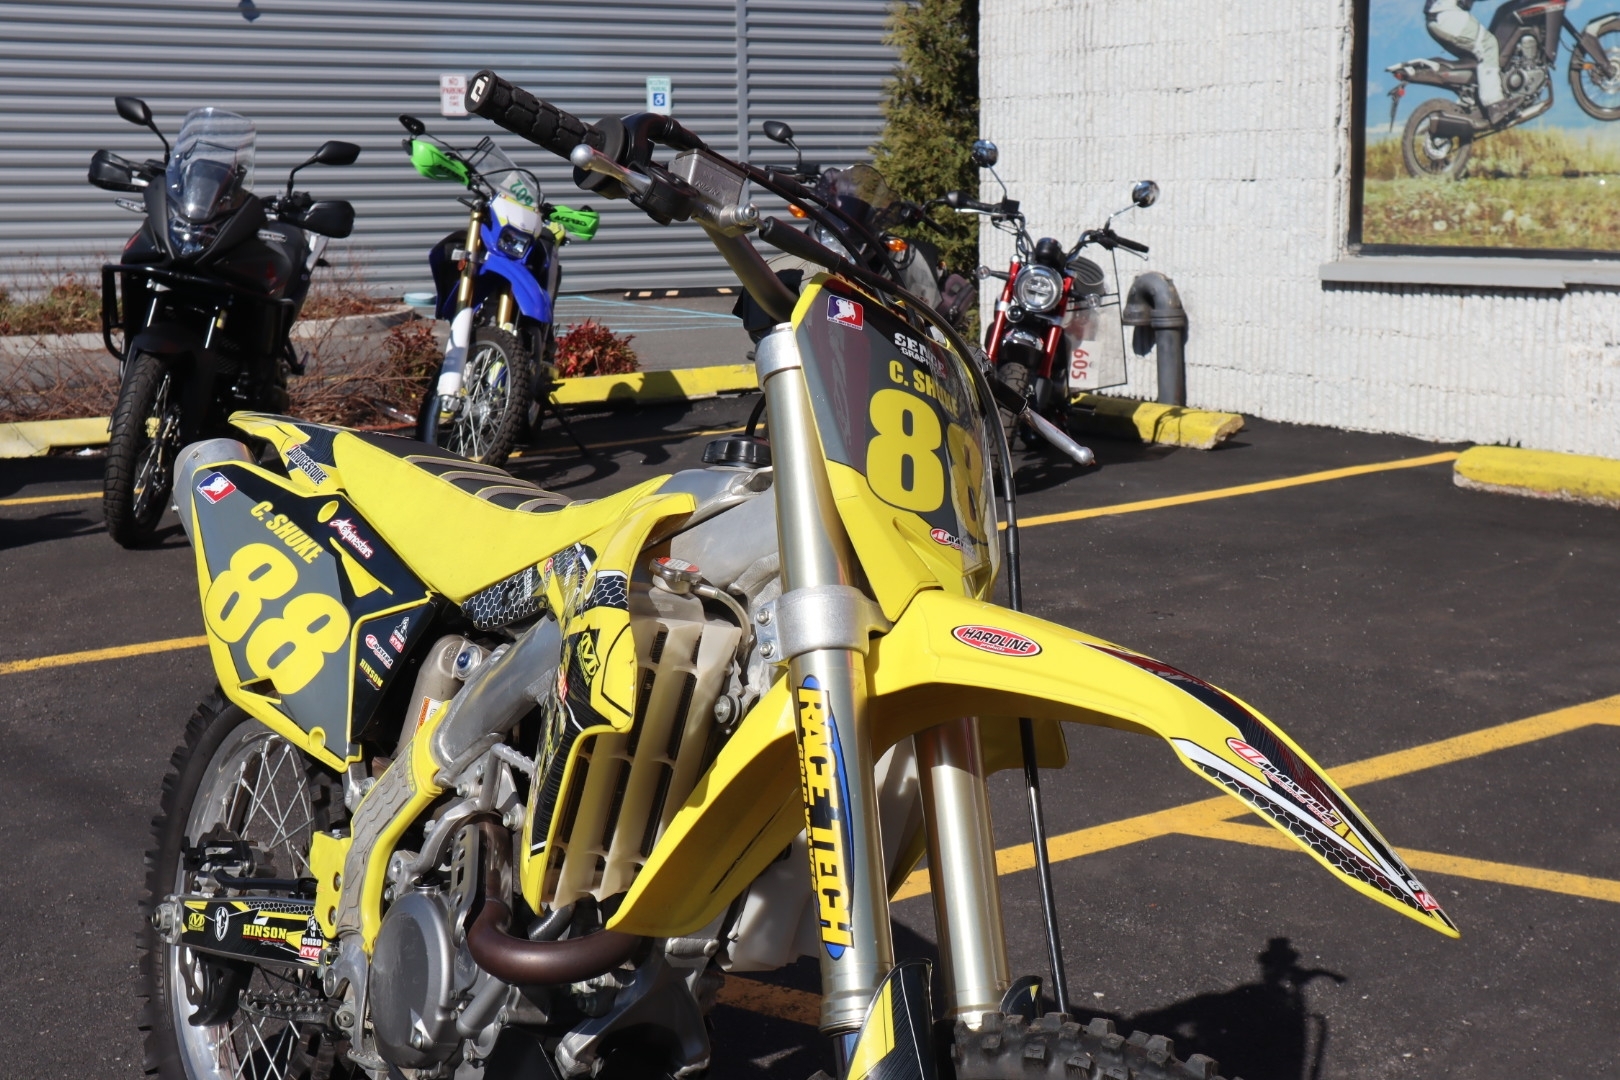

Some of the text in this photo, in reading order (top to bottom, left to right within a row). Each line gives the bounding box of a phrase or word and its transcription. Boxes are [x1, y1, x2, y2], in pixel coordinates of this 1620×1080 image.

[889, 360, 909, 386] C.
[1071, 349, 1091, 380] 605
[285, 444, 328, 486] BRIDGESTONE
[866, 389, 985, 544] 88
[250, 501, 324, 564] C. SHUKE
[338, 524, 374, 559] alpinestars
[205, 543, 350, 694] 88
[962, 627, 1032, 652] HARDLINE
[359, 657, 384, 687] HINSON
[798, 743, 808, 802] GOLD
[797, 687, 854, 947] RACE TECH
[242, 923, 288, 940] HINSON
[301, 936, 322, 947] enzo
